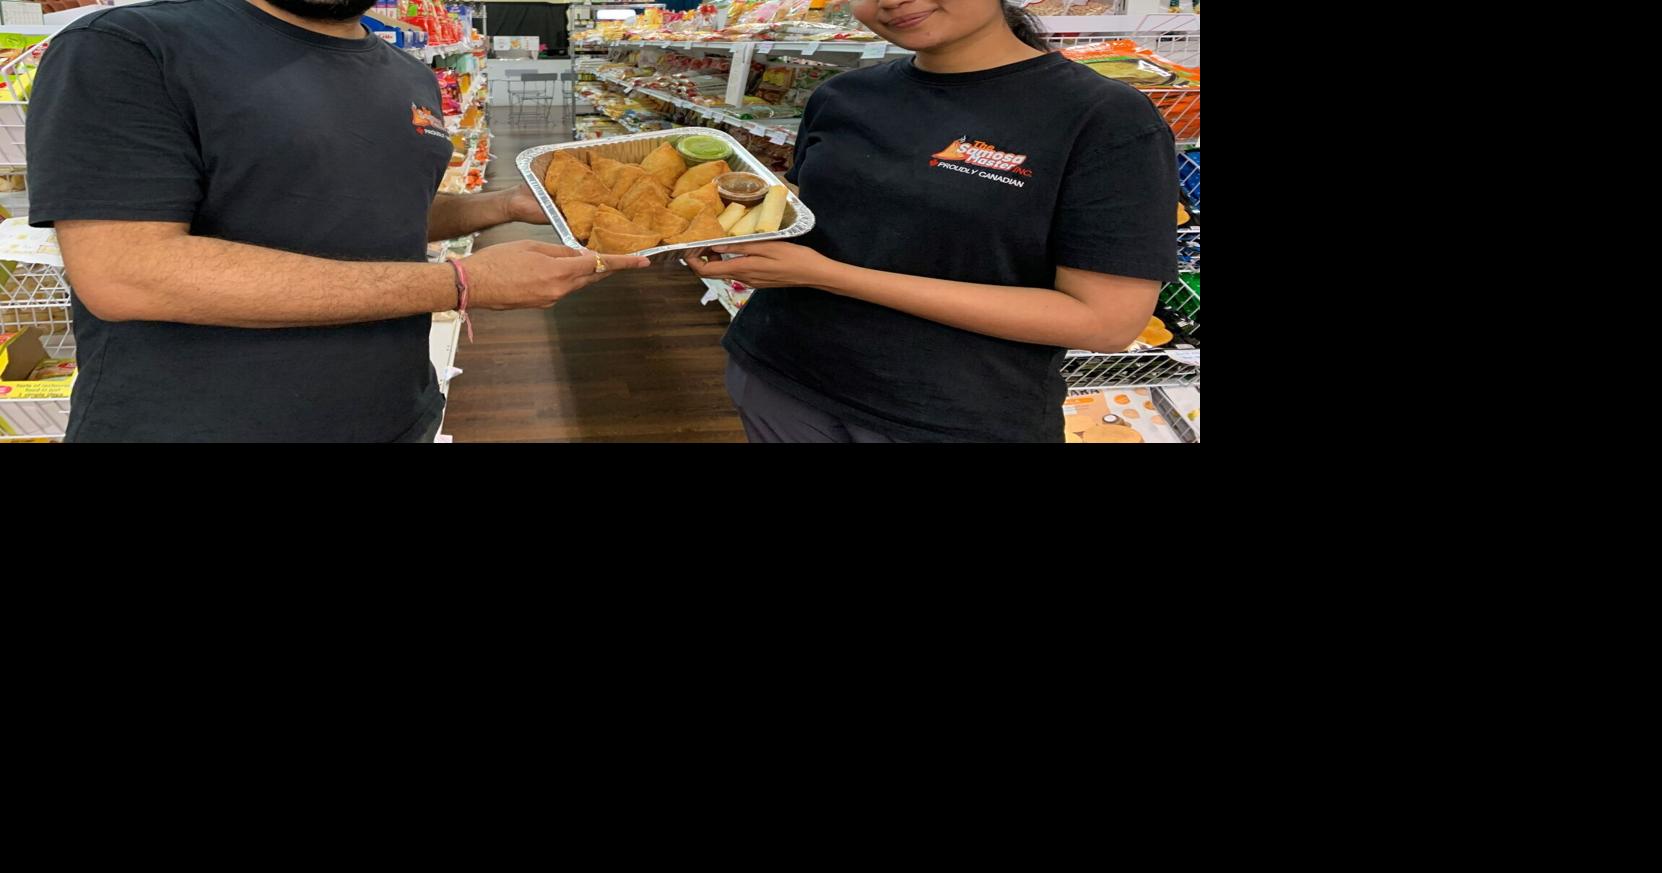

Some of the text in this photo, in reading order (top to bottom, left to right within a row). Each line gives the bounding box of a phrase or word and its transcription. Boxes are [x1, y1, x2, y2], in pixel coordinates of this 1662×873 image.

[956, 143, 1026, 164] Samosa
[974, 140, 996, 151] The
[965, 154, 1017, 171] Master
[937, 161, 1025, 187] PROUDLY CANADIAN
